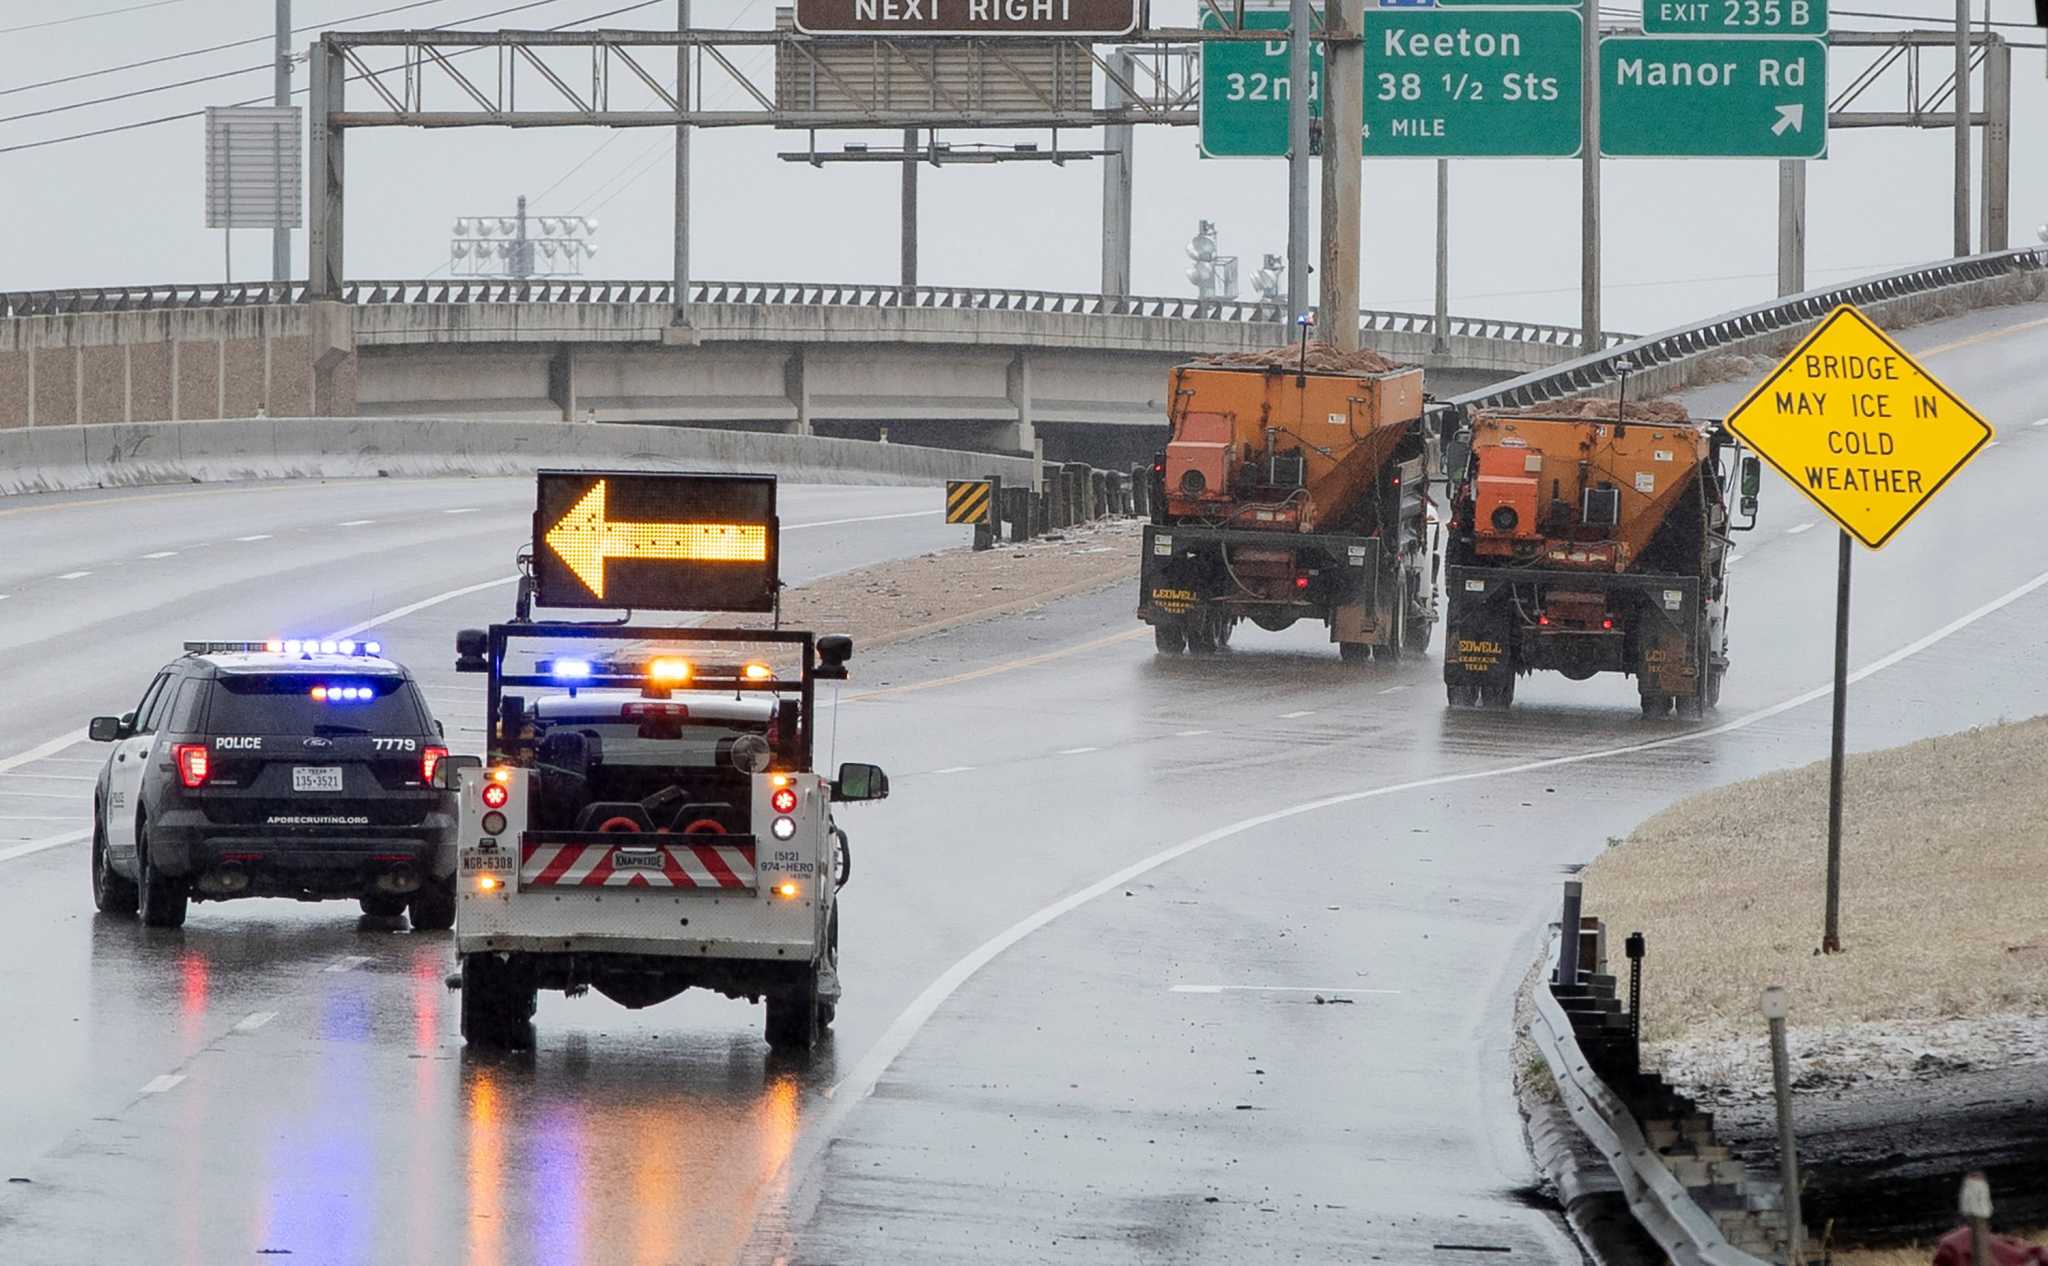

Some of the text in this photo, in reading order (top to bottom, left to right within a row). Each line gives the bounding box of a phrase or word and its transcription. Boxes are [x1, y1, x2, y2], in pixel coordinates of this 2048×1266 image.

[855, 0, 1069, 21] NEXT RIGHT
[1661, 3, 1710, 21] EXIT
[1723, 0, 1781, 26] 235
[1385, 28, 1520, 57] Keeton
[1617, 57, 1805, 87] Manor Rd
[1377, 72, 1421, 101] 38
[1502, 72, 1559, 101] Sts
[1392, 119, 1445, 136] MILE
[1805, 355, 1899, 380] BRIDGE
[1775, 391, 1938, 418] MAY ICE IN
[1828, 431, 1894, 455] COLD
[1804, 465, 1924, 494] WEATHER
[216, 736, 262, 750] POLICE
[372, 738, 416, 751] 7779
